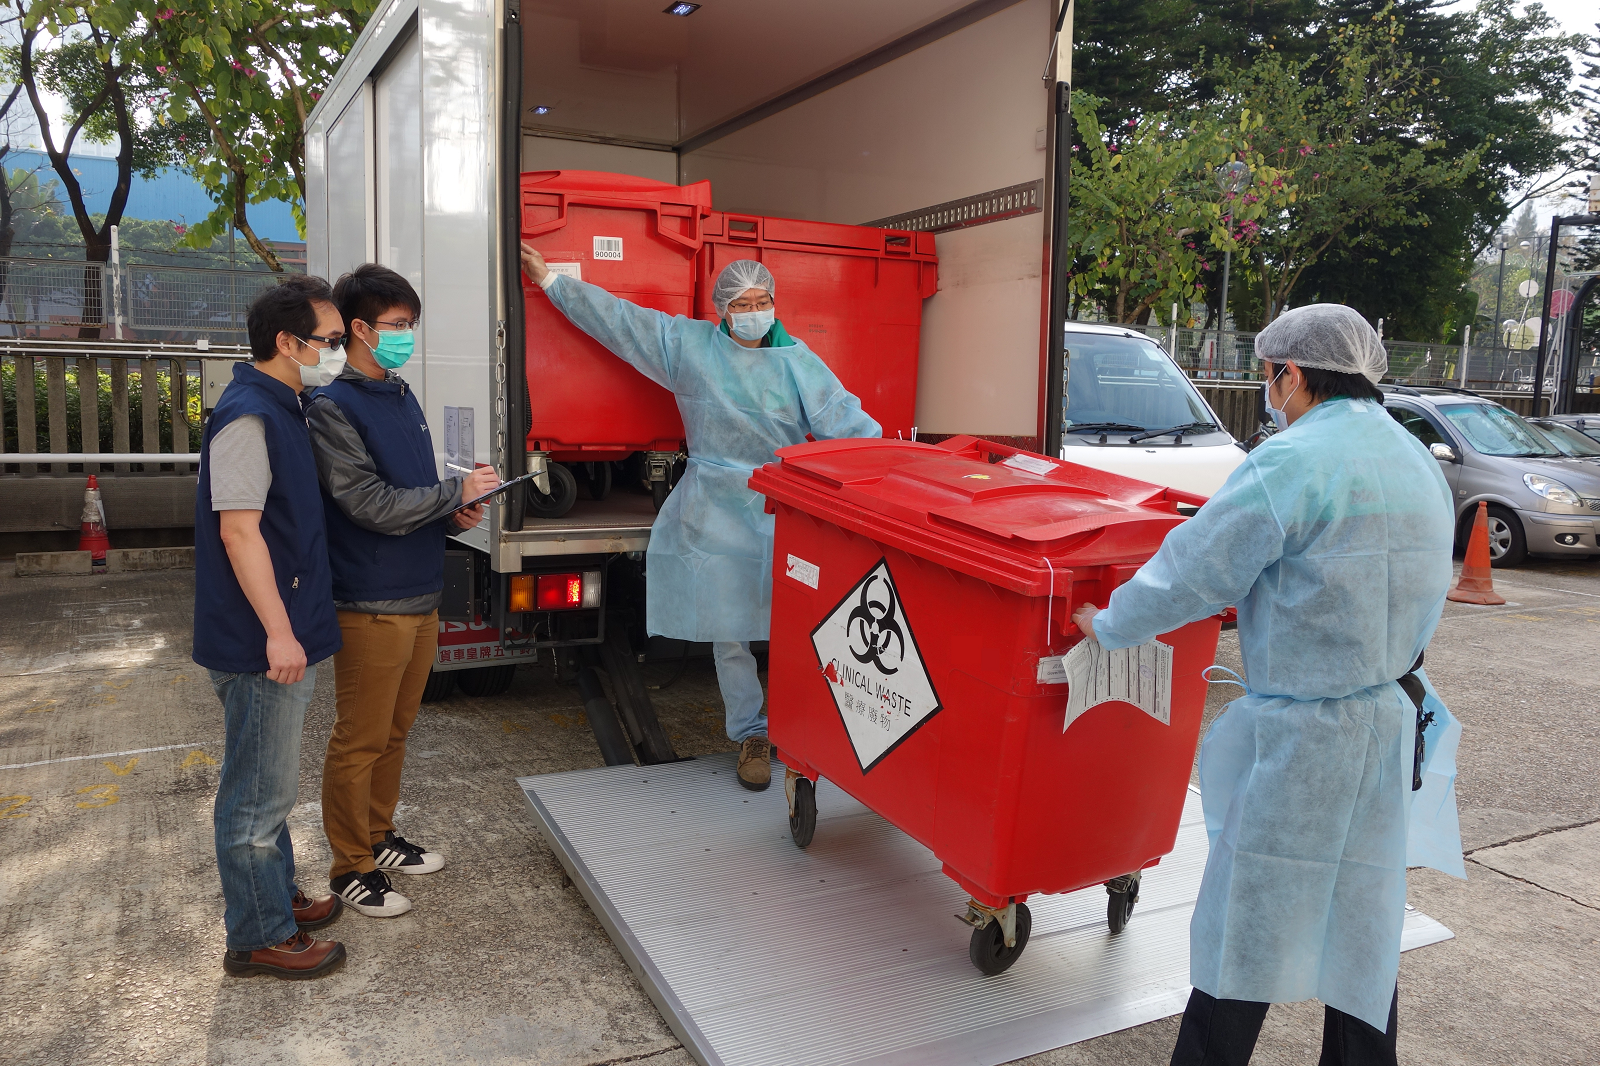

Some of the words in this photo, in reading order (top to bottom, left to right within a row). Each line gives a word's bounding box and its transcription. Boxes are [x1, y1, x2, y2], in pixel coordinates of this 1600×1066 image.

[440, 644, 530, 663] 貨車皇牌五
[844, 691, 891, 732] 醫療廢物
[875, 682, 912, 718] WASTE
